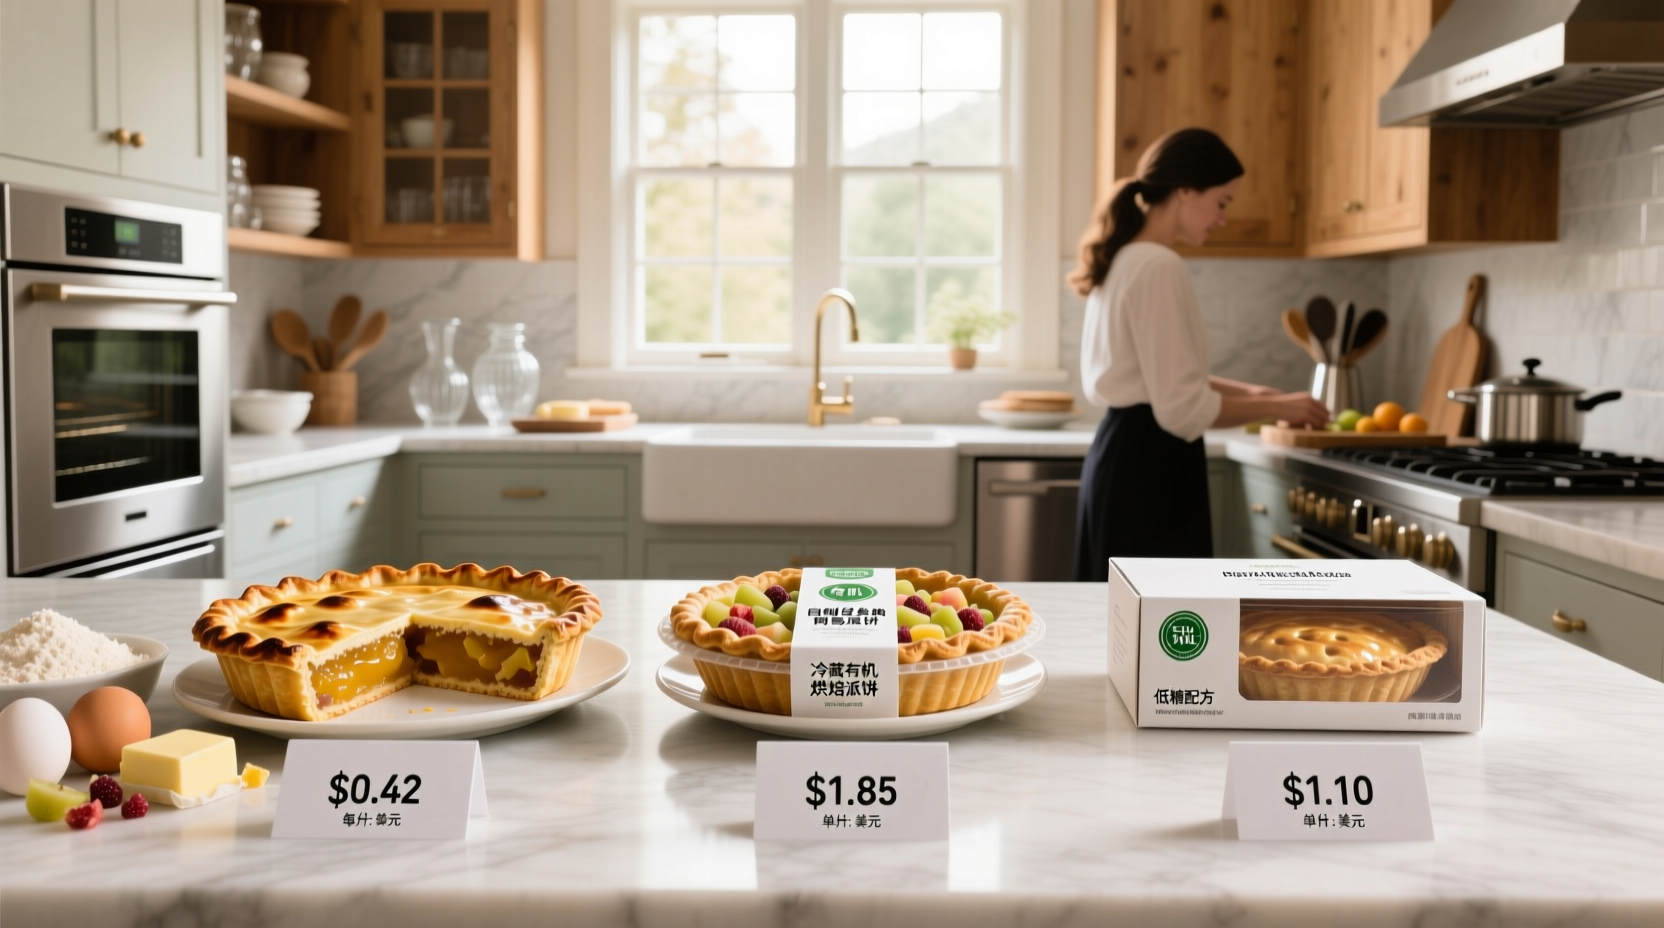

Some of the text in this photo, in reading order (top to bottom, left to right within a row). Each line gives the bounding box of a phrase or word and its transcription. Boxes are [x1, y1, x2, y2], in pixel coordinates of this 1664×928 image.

[811, 662, 878, 678] 冷藏有机
[328, 770, 421, 809] $0.42
[806, 771, 896, 810] $1.85
[1283, 771, 1373, 810] $1.10
